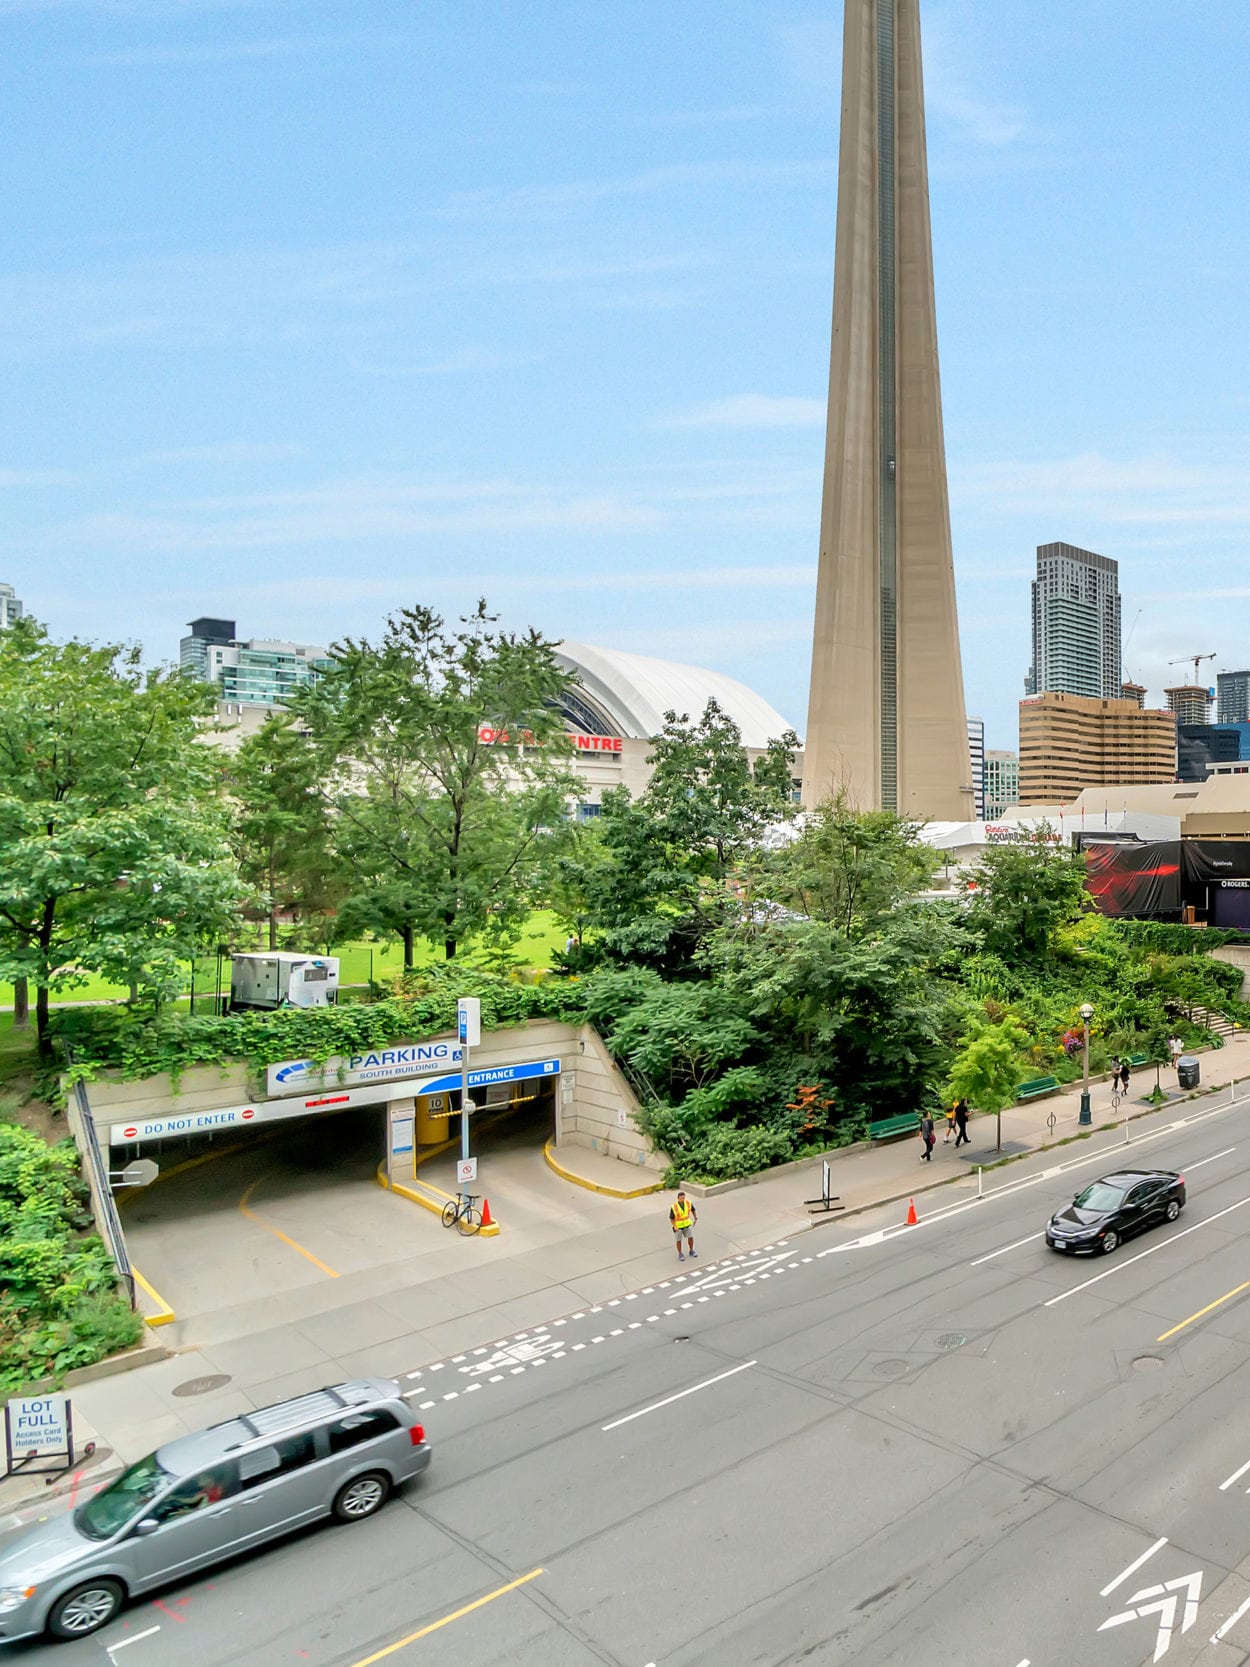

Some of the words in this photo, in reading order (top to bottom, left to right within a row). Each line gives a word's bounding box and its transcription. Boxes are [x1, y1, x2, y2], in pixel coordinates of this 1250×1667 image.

[349, 1045, 448, 1070] PARKING
[360, 1069, 394, 1079] SOUTH
[394, 1063, 438, 1075] BUILDING
[468, 1069, 514, 1084] ENTRANCE
[144, 1123, 163, 1135] DO
[167, 1118, 191, 1131] NOT
[197, 1112, 235, 1127] ENTER
[22, 1400, 53, 1414] LOT
[18, 1414, 58, 1428] FULL
[15, 1430, 42, 1439] Access
[43, 1427, 62, 1436] Card
[15, 1438, 44, 1447] Holders
[46, 1436, 62, 1444] Only
